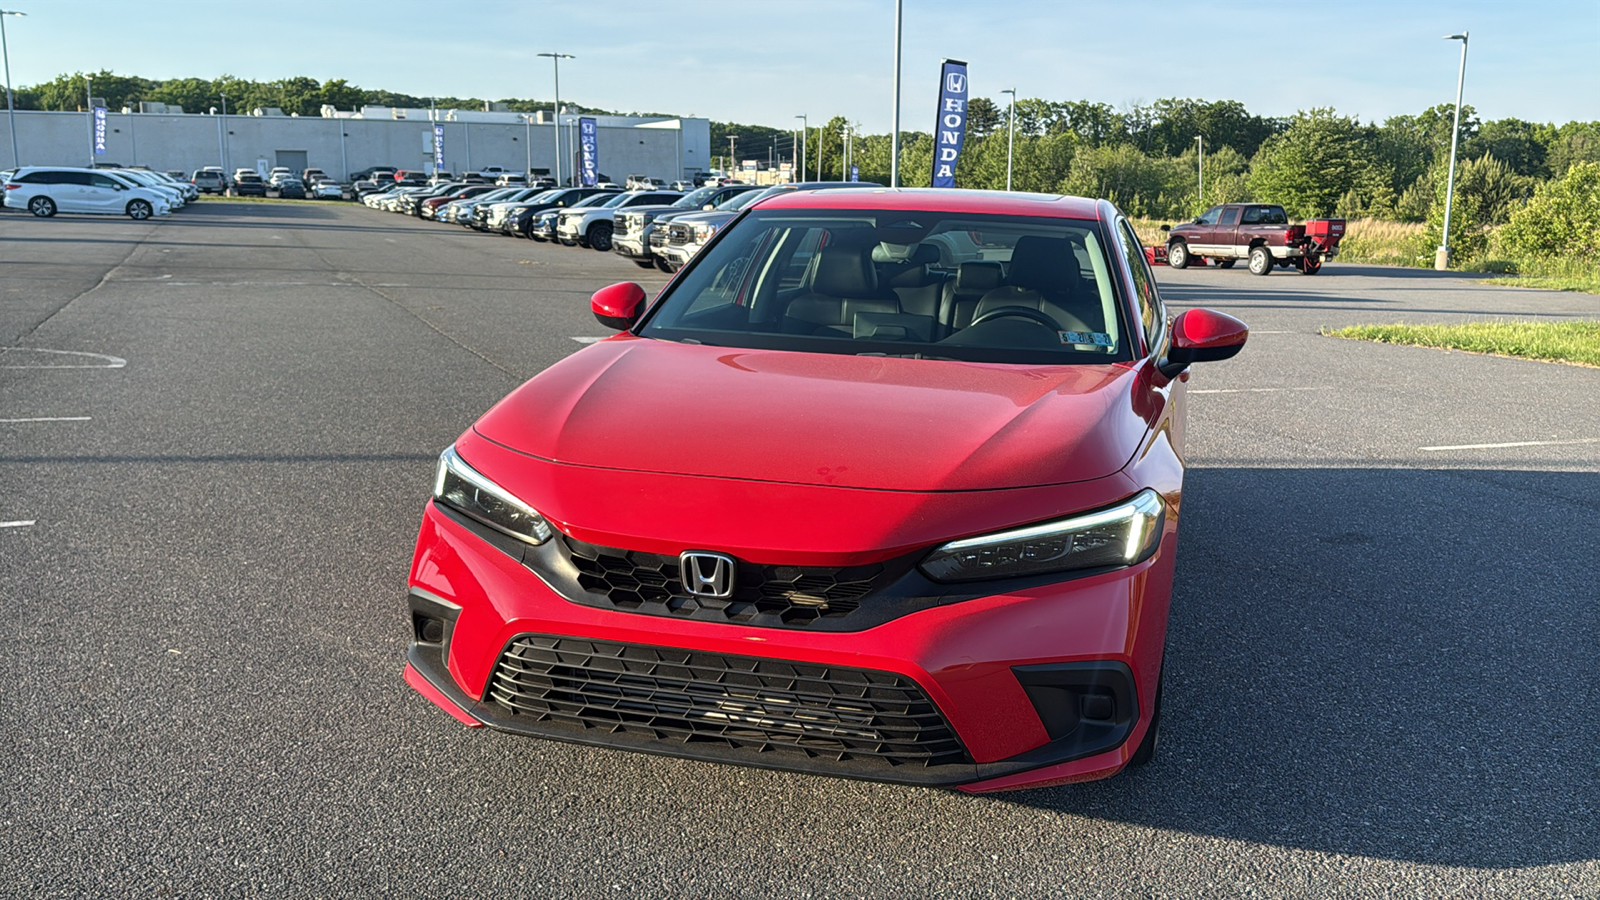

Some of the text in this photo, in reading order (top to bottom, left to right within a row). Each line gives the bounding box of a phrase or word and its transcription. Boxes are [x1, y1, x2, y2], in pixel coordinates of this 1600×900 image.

[95, 118, 106, 150] HONDA
[435, 136, 444, 164] HONDA
[937, 98, 965, 177] HONDA
[581, 136, 596, 178] HONDA
